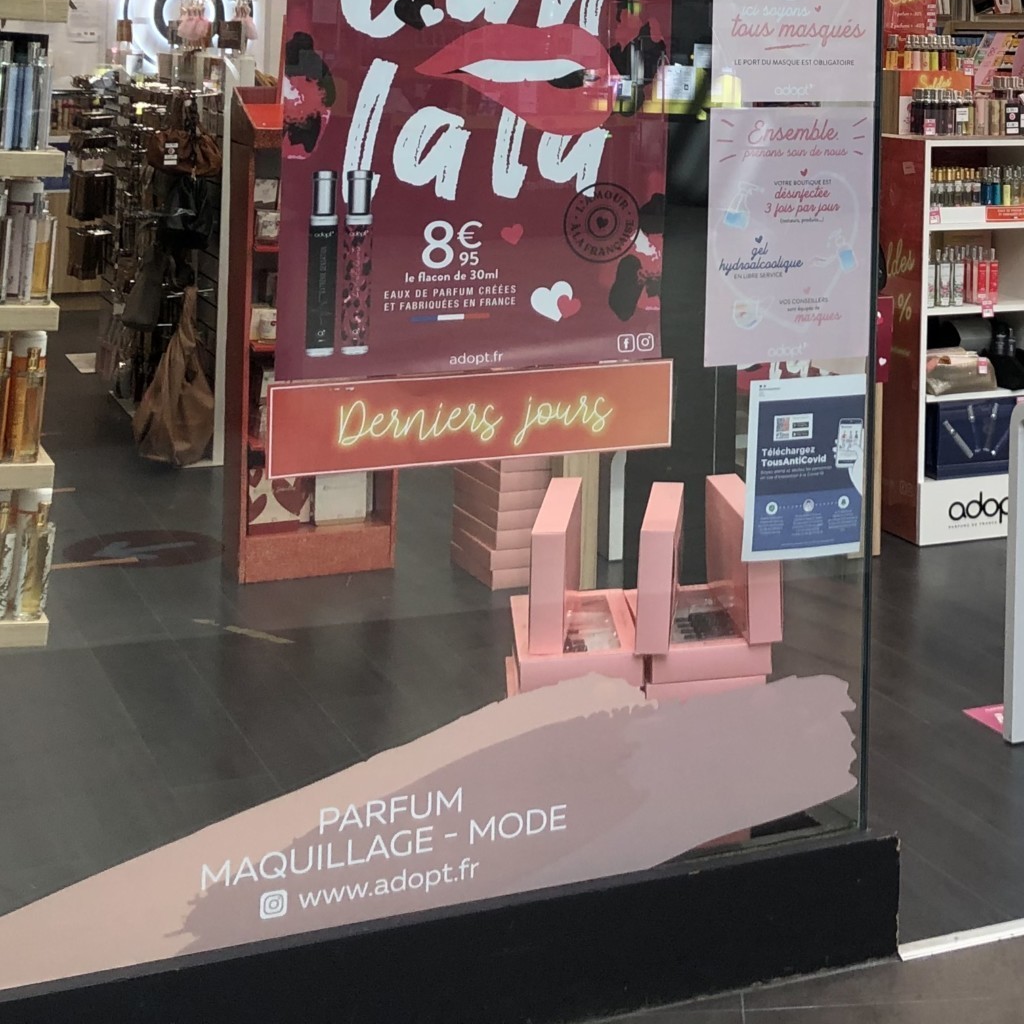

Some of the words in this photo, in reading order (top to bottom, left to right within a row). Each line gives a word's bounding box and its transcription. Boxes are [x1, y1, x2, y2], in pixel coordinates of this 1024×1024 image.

[731, 14, 776, 38] tous
[777, 18, 866, 48] masqués
[772, 59, 800, 67] MASQUE
[809, 145, 822, 157] de
[824, 148, 848, 157] nous
[764, 202, 772, 214] 3
[459, 251, 480, 267] 95
[751, 242, 769, 261] gel
[719, 256, 804, 276] hydroalcoolique
[405, 272, 415, 283] le
[418, 271, 451, 283] flacon
[453, 270, 467, 281] de
[469, 269, 499, 280] 30ml
[384, 290, 411, 300] EAUX
[415, 288, 429, 299] DE
[433, 287, 474, 297] PARFUM
[478, 284, 517, 295] CRÉÉES
[384, 302, 396, 312] ET
[400, 299, 460, 311] FABRIQUÉES
[463, 299, 476, 308] EN
[480, 296, 517, 306] FRANCE
[449, 350, 504, 365] adopt.fr
[338, 399, 503, 446] Derniers
[514, 393, 613, 447] jours
[761, 446, 815, 457] Téléchargez
[761, 454, 827, 467] TousAntiCovid
[319, 787, 463, 835] PARFUM
[200, 826, 434, 891] MAQUILLAGE
[469, 804, 567, 845] MODE
[298, 857, 480, 910] www.adopt.fr
